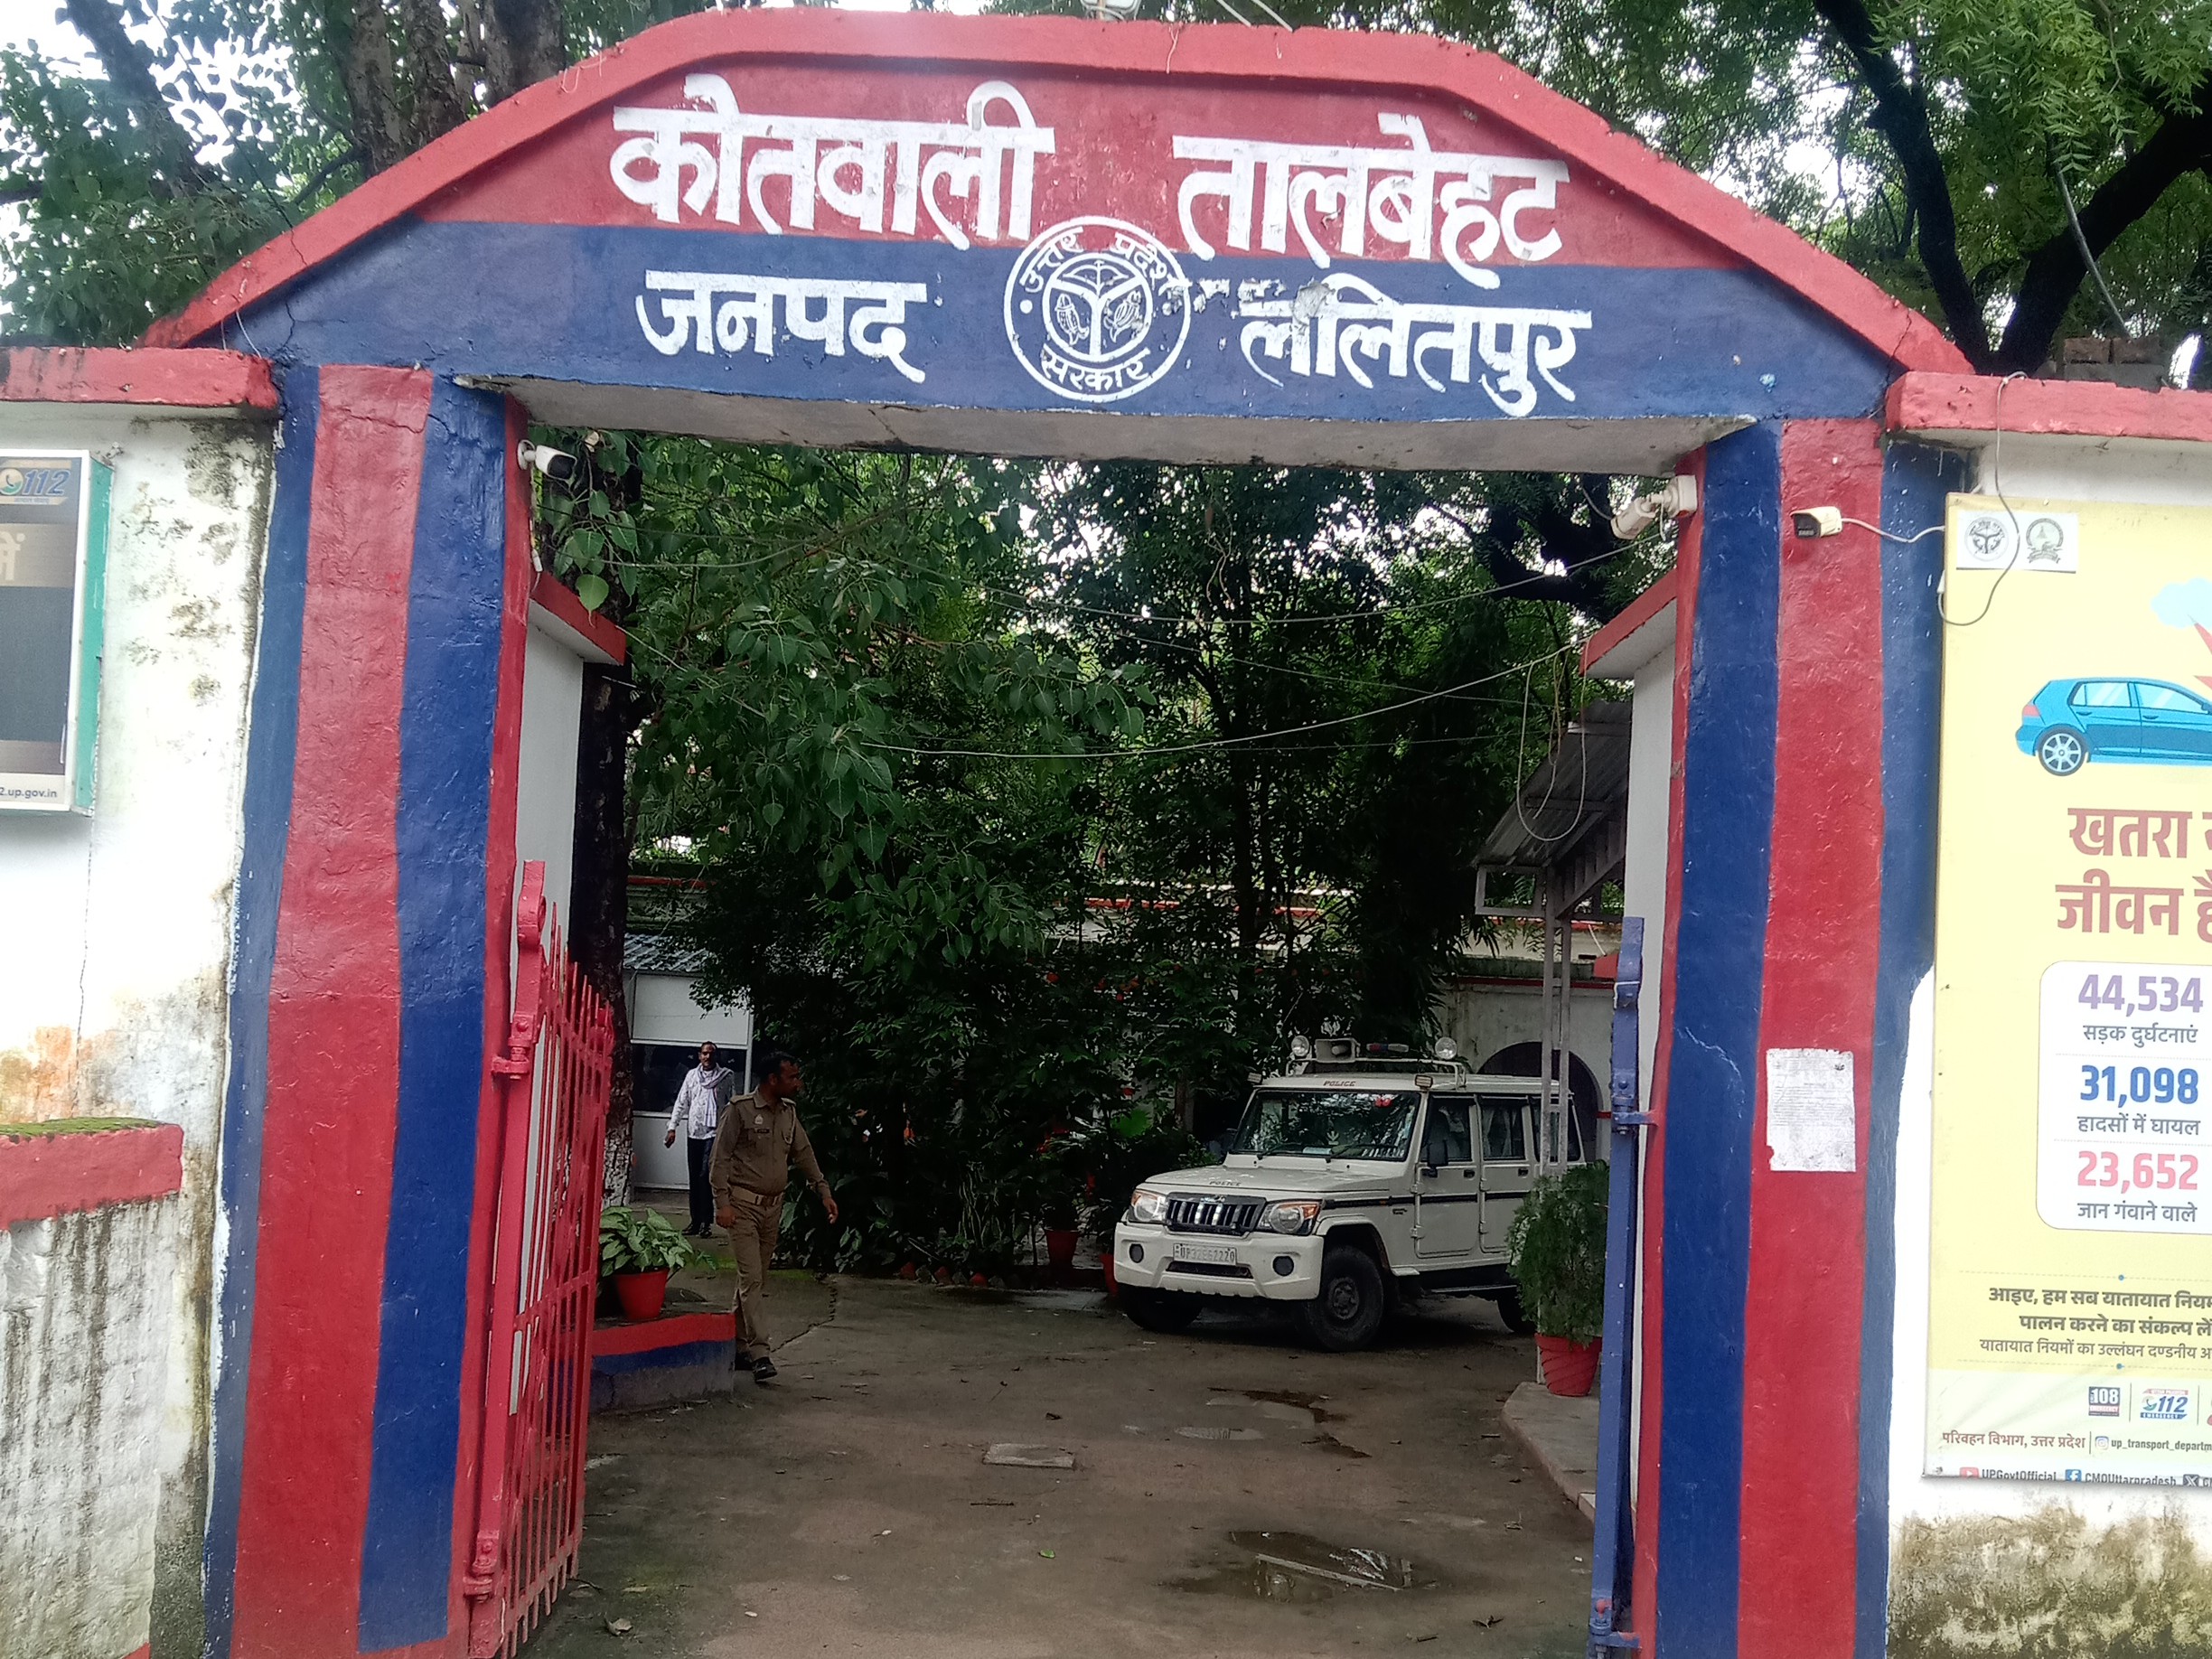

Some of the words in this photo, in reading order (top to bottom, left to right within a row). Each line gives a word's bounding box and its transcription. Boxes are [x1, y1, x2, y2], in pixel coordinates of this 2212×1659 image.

[610, 74, 1055, 250] कोतवाली
[1173, 112, 1570, 289] तालबेहट
[1019, 226, 1084, 294] उत्तर
[636, 270, 927, 383] जनपद
[1041, 343, 1151, 390] सरकार
[22, 469, 71, 496] 112
[2067, 808, 2192, 858] खतरा
[2055, 868, 2184, 935] जीवन
[2078, 974, 2203, 1017] 44,534
[2083, 1026, 2127, 1045] सड़क
[2131, 1022, 2198, 1048] दुर्घटनाएं
[2081, 1065, 2198, 1108] 31,098
[2077, 1112, 2129, 1132] हादसों
[2132, 1113, 2146, 1133] में
[2151, 1119, 2201, 1135] घायल
[2077, 1151, 2198, 1194] 23,652
[2077, 1203, 2110, 1218] जान
[2114, 1200, 2158, 1220] गंवाने
[2161, 1202, 2198, 1222] वाले
[1989, 1288, 2038, 1306] आइए,
[2042, 1289, 2067, 1305] हम
[2070, 1291, 2099, 1305] सब
[2102, 1292, 2171, 1308] यातायात
[2019, 1316, 2067, 1330] पालन
[2069, 1314, 2109, 1332] करने
[2112, 1319, 2135, 1333] का
[2138, 1316, 2193, 1336] संकल्प
[1980, 1339, 2034, 1353] यातायात
[2037, 1337, 2074, 1354] नियमों
[2076, 1343, 2095, 1354] का
[2098, 1342, 2145, 1356] उल्लंघन
[2148, 1343, 2198, 1359] दण्डनीय
[2091, 1388, 2119, 1405] 108
[2158, 1395, 2189, 1413] 112
[1943, 1429, 1985, 1446] परिवहन
[1988, 1431, 2027, 1448] विभाग,
[2031, 1436, 2055, 1447] उत्तर
[2058, 1433, 2085, 1448] प्रदेश
